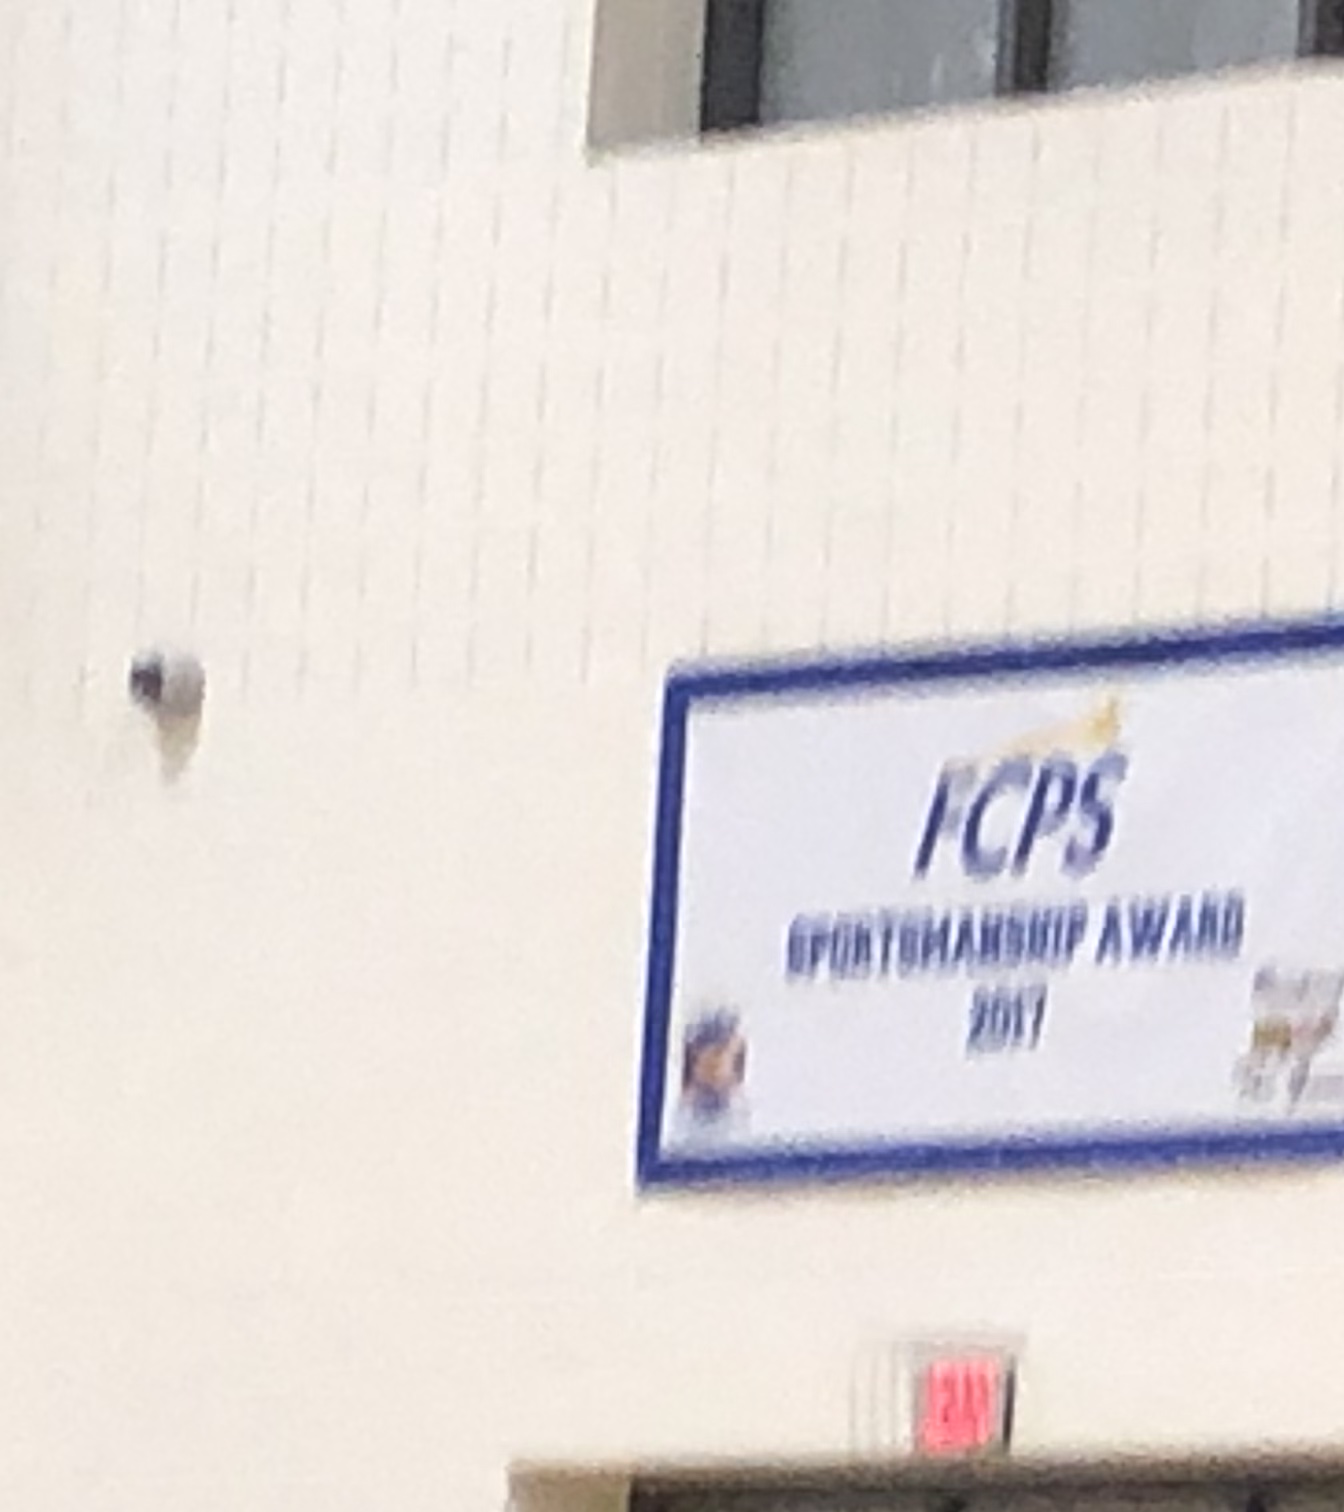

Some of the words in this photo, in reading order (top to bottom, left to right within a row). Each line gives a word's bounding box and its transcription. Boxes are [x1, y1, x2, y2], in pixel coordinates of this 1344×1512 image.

[913, 748, 1129, 880] FCPS
[785, 895, 1090, 982] SPORTSMANSHIP
[1095, 887, 1246, 966] AWARD
[966, 982, 1048, 1059] 2017
